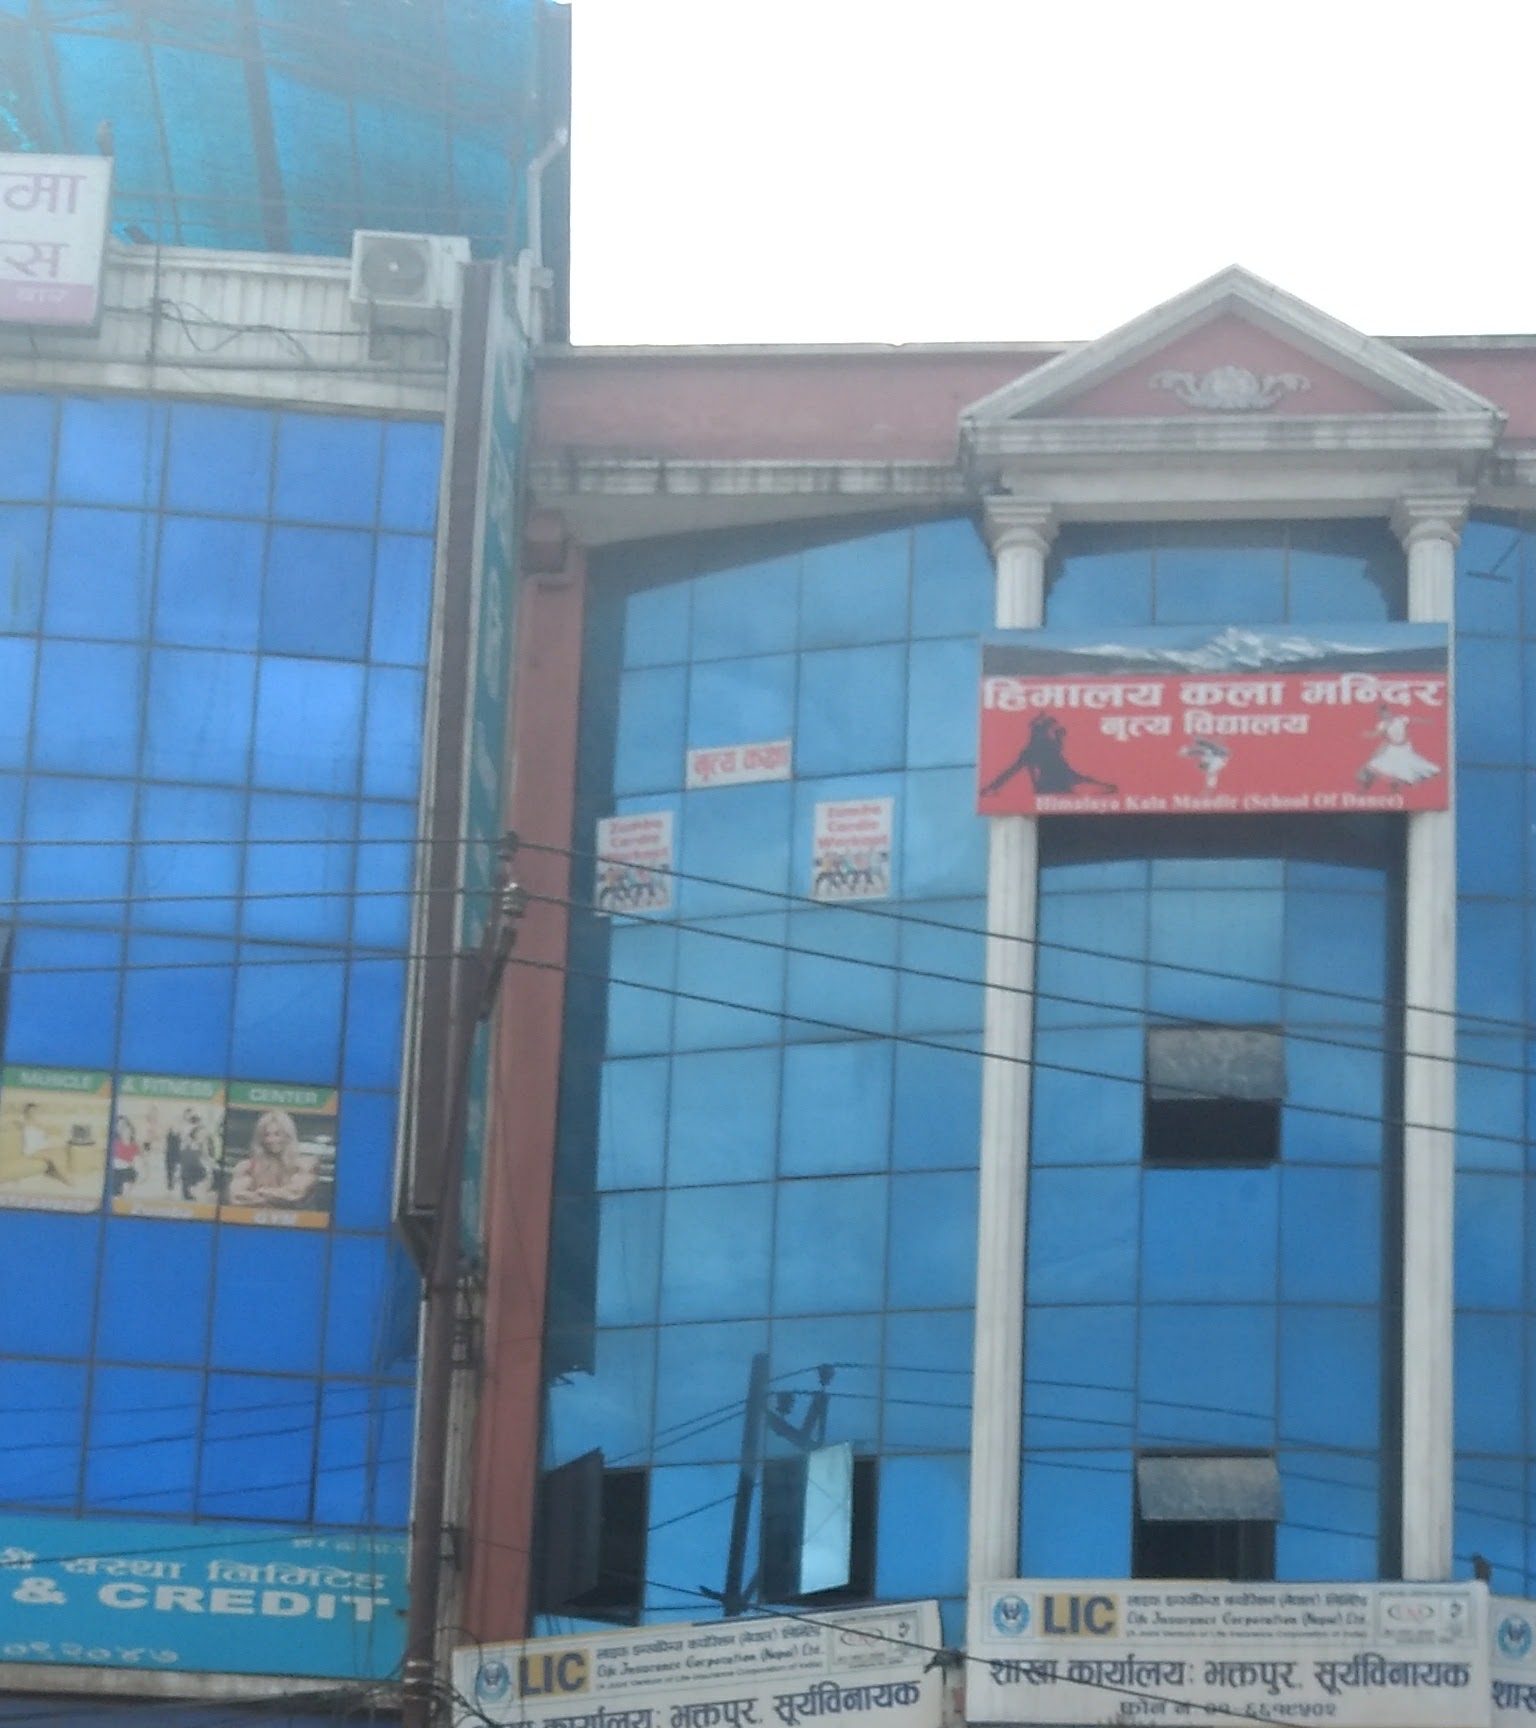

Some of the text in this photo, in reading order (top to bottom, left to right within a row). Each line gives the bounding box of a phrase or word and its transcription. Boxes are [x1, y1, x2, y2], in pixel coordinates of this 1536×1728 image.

[983, 679, 1164, 711] हिमालय
[1180, 681, 1285, 707] कला
[12, 1577, 66, 1605] &
[97, 1581, 390, 1622] CREDIT
[1042, 1596, 1117, 1635] LIC
[518, 1651, 587, 1697] LIC
[989, 1658, 1058, 1688] शाखा
[1066, 1652, 1194, 1688] कार्यालय:
[1314, 1651, 1470, 1695] सूर्यविनायक
[773, 1680, 921, 1726] सूर्यविनायक
